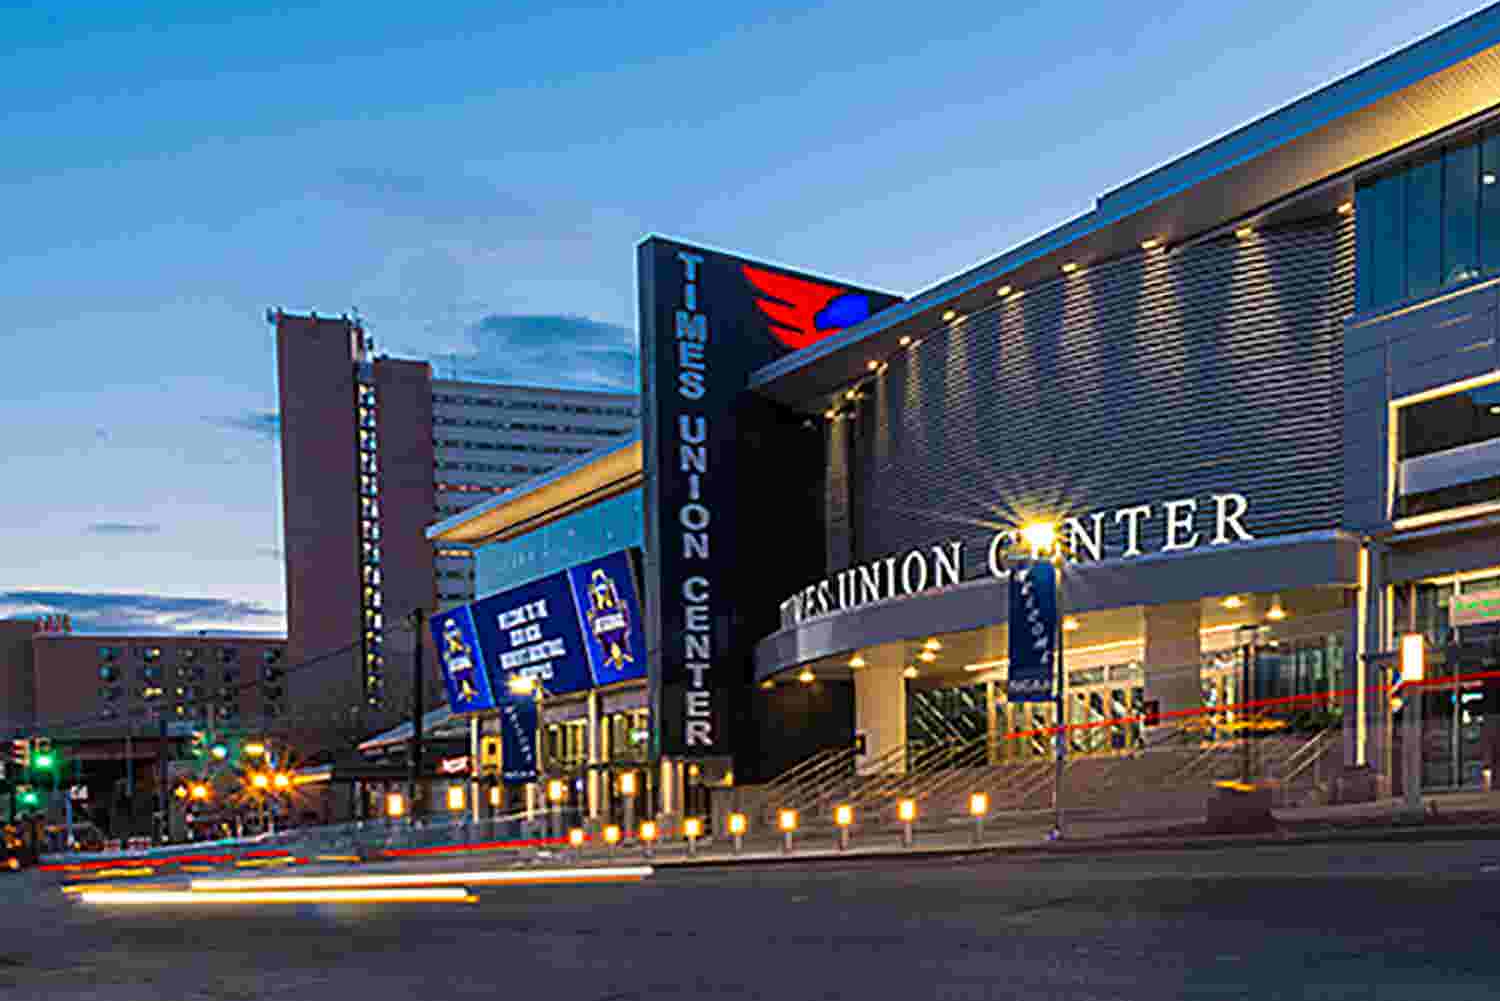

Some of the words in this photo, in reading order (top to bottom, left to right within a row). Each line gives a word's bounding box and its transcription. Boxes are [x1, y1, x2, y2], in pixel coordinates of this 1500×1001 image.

[676, 251, 706, 400] TIMES
[679, 414, 711, 559] UNION
[837, 541, 961, 612] UNION
[988, 493, 1255, 579] CNTER
[682, 575, 713, 746] CENTER
